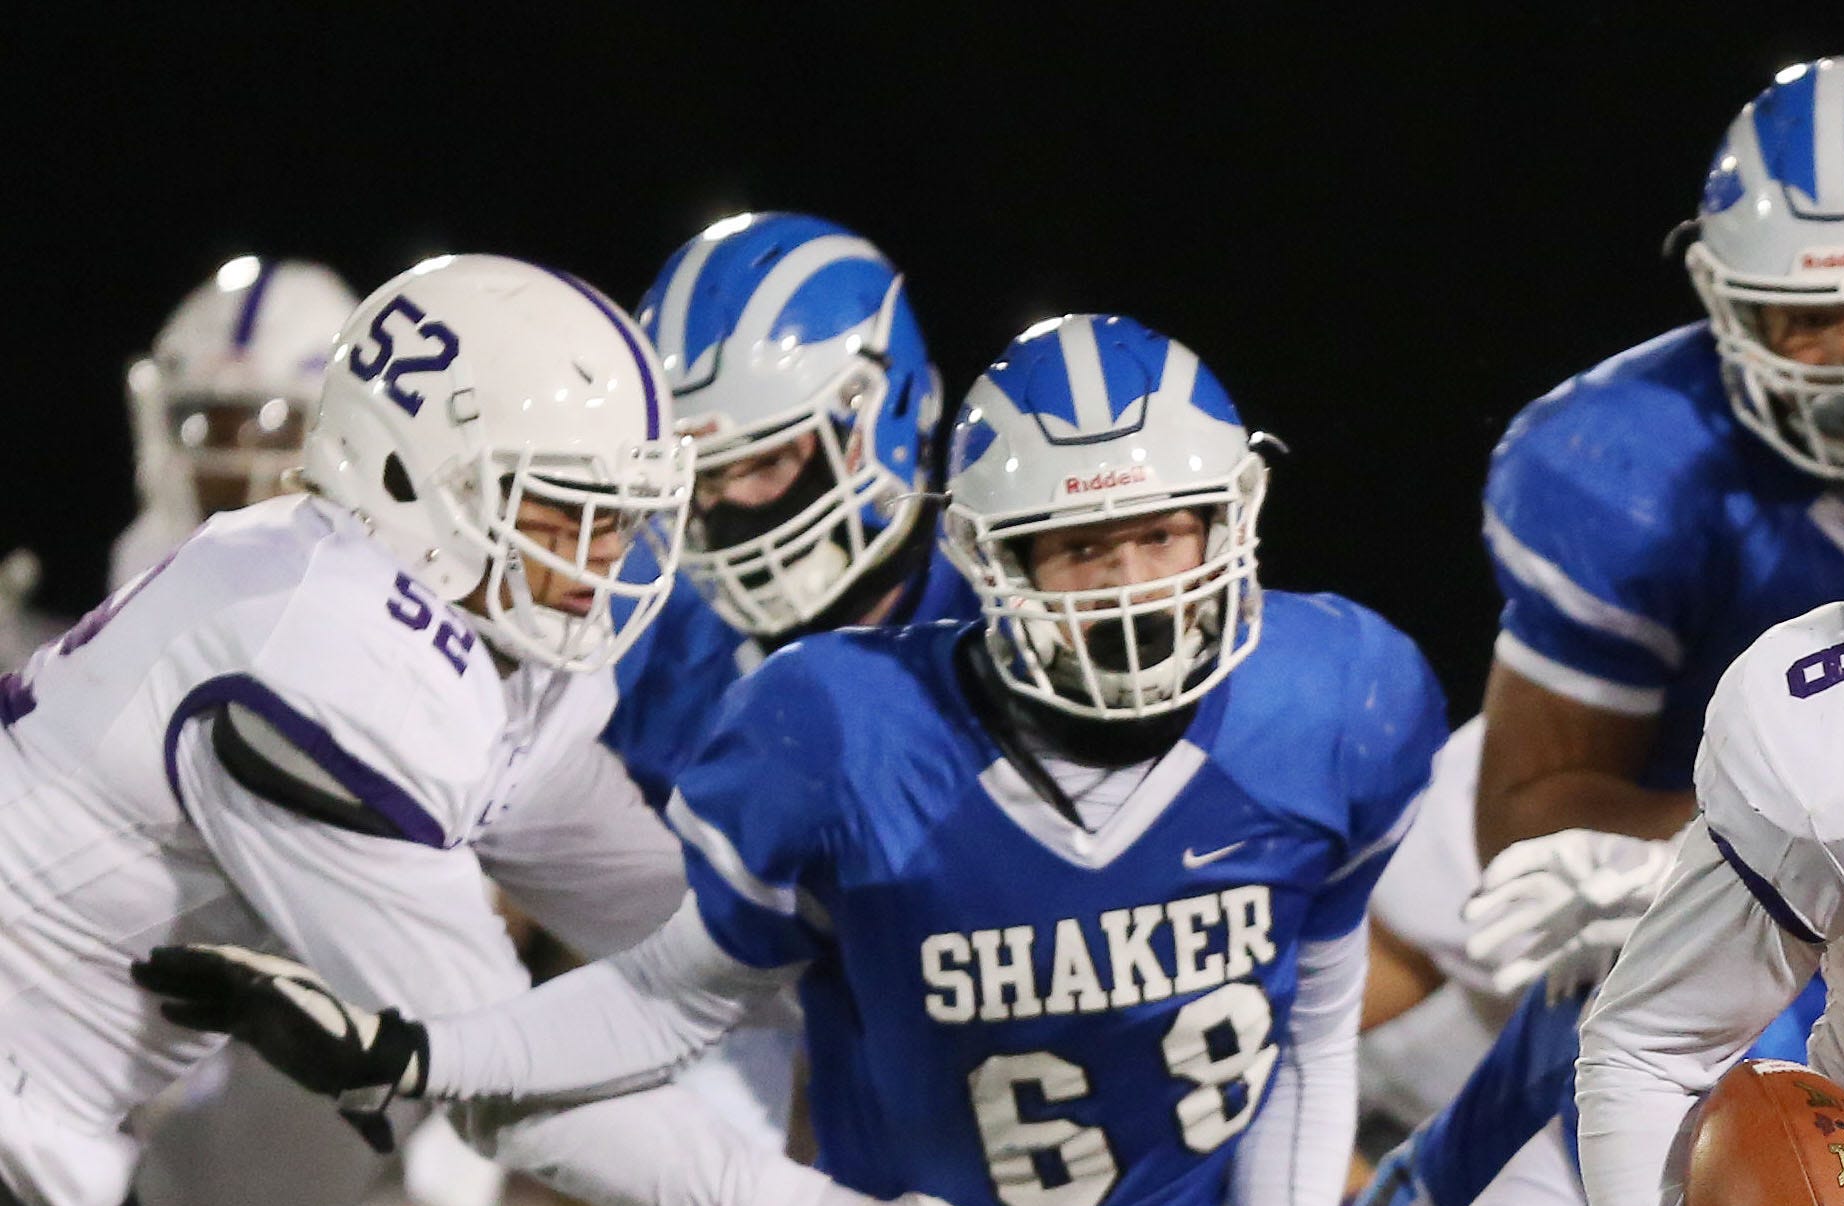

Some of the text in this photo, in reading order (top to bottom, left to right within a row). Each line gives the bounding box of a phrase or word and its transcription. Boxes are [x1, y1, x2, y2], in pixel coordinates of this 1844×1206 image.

[350, 294, 460, 418] 52
[1066, 465, 1146, 494] Riddell
[386, 571, 477, 679] 52
[920, 885, 1276, 1025] SHAKER
